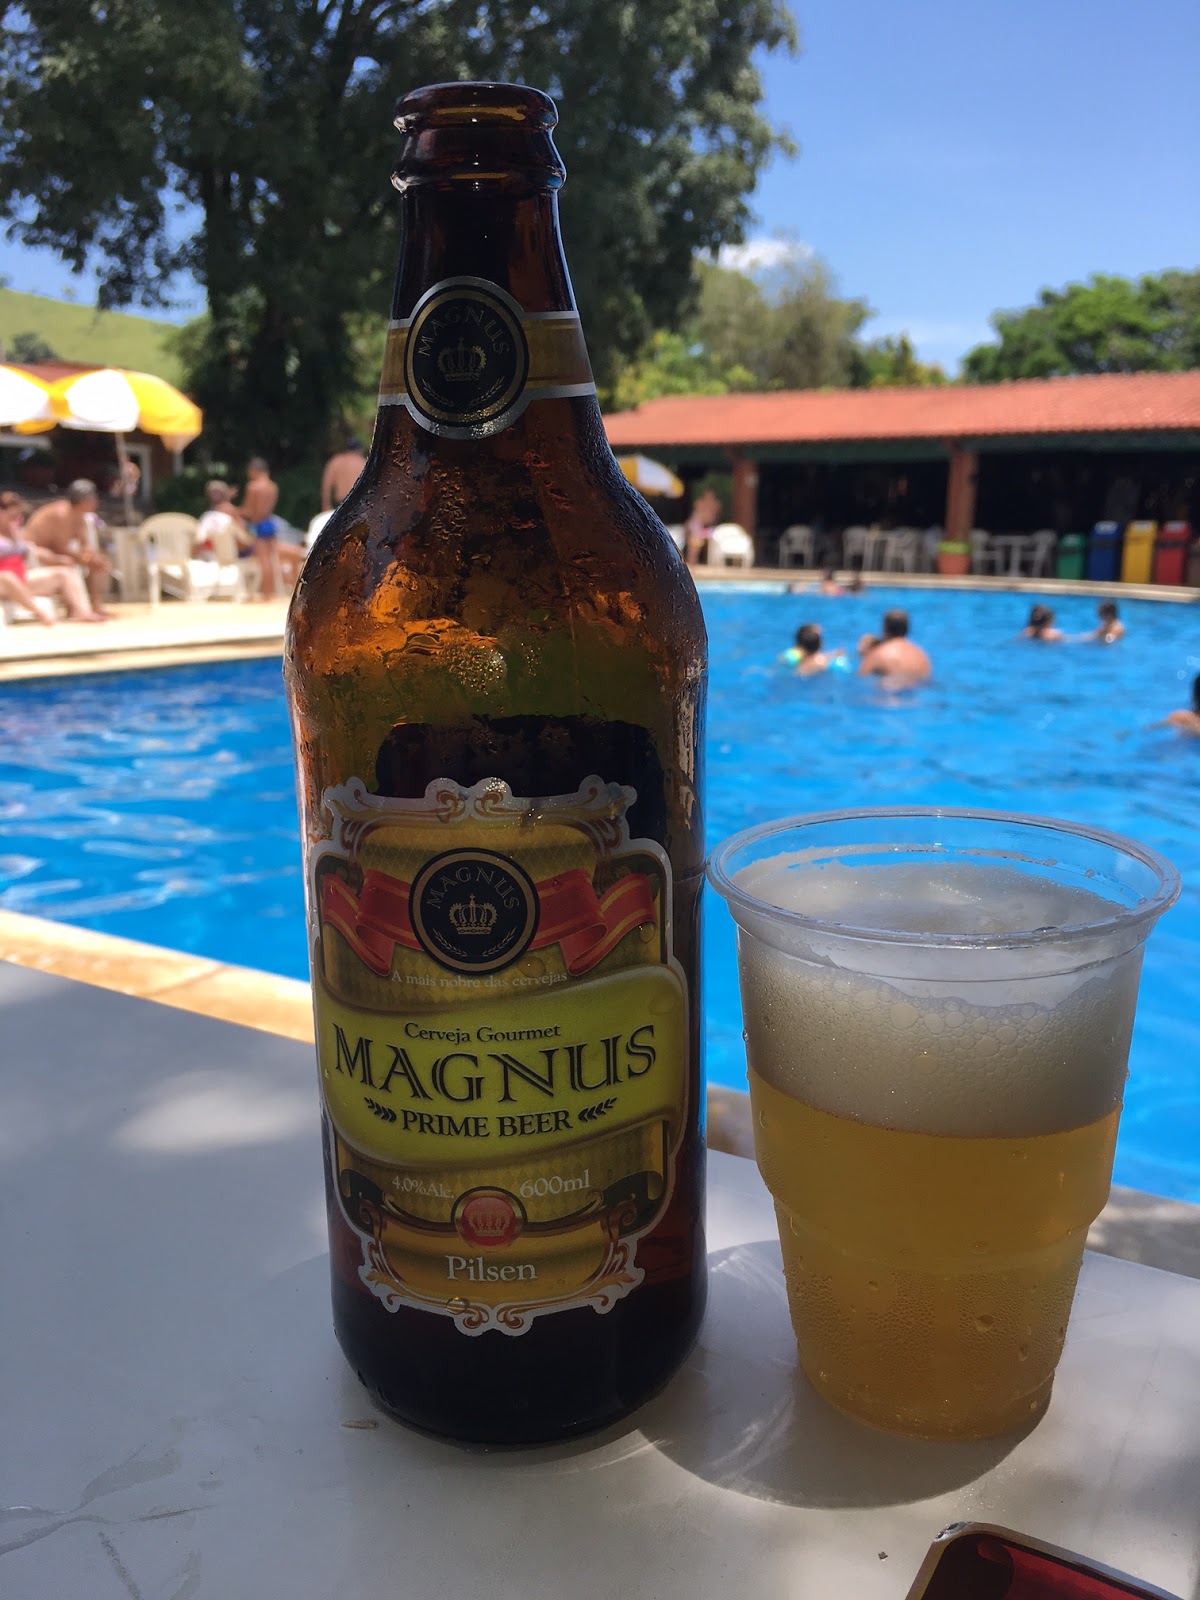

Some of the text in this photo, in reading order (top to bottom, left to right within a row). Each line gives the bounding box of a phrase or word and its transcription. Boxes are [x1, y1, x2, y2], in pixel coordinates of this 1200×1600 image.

[418, 305, 509, 358] MAGNUS
[426, 866, 519, 909] MAGNUS
[391, 970, 568, 988] A mais nobre das cervejas
[404, 1022, 561, 1046] Cerveja Gourmet
[332, 1023, 657, 1103] MAGNUS
[402, 1109, 574, 1138] PRIME BEER
[519, 1169, 591, 1199] 600ml
[445, 1255, 538, 1282] Pilsen
